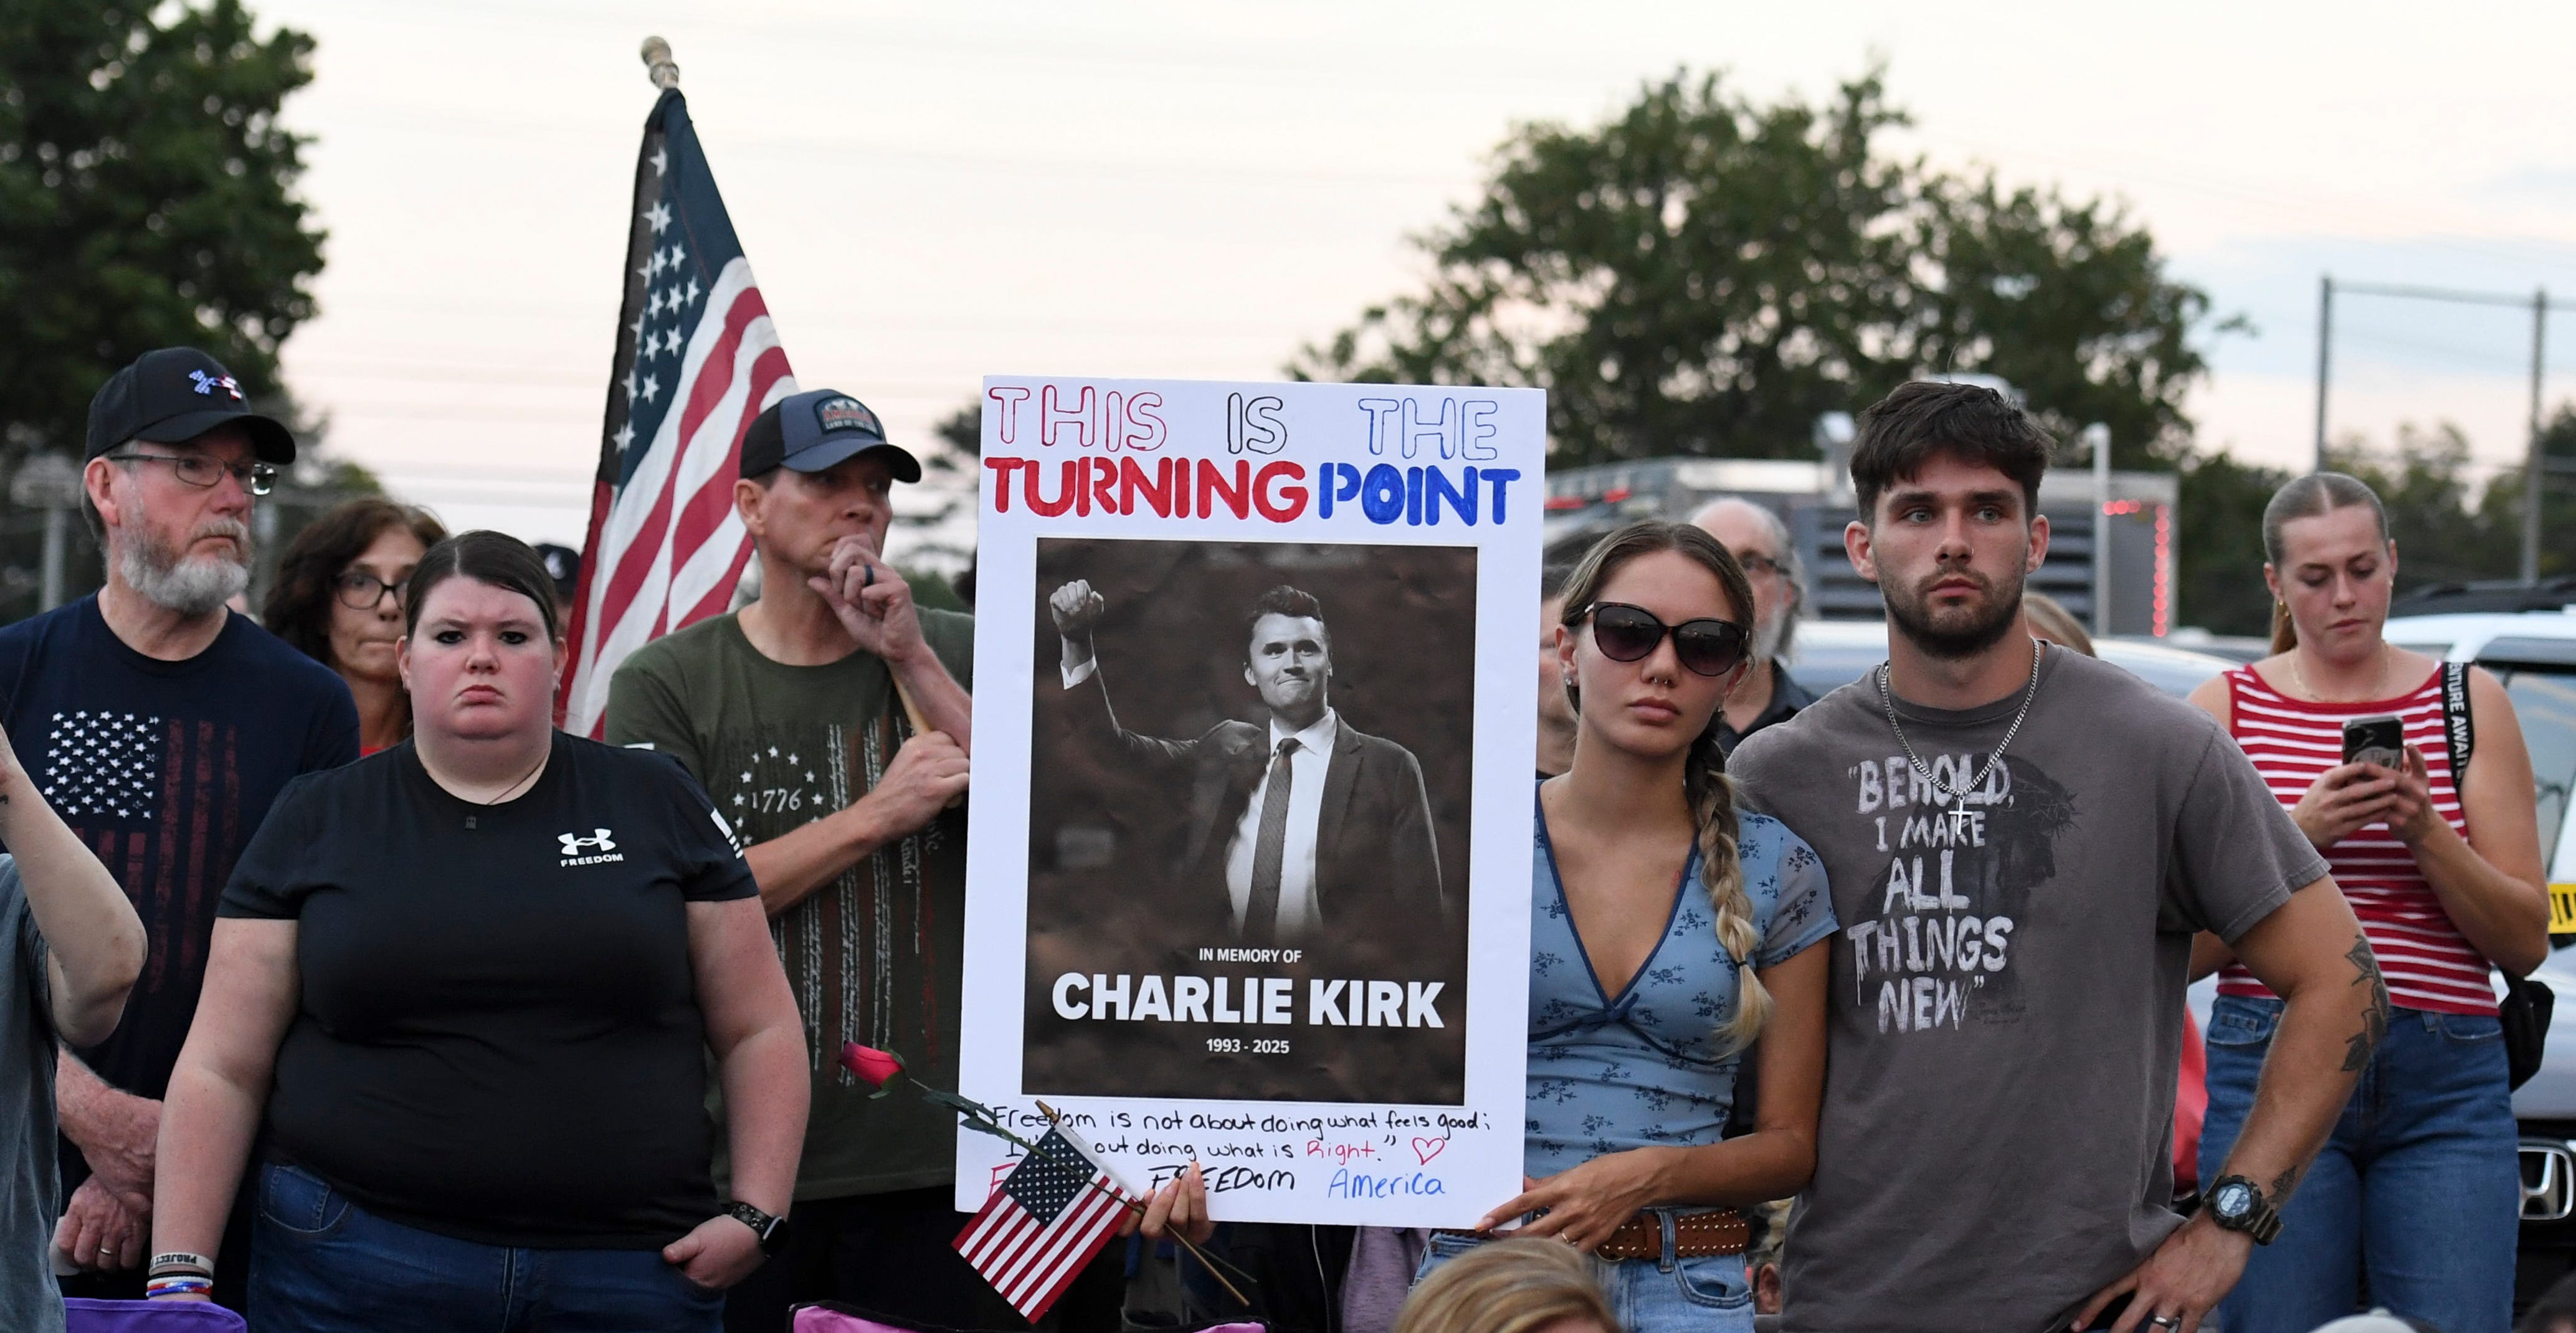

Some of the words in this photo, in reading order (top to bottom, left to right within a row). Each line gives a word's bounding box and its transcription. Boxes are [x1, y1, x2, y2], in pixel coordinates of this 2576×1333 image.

[988, 384, 1167, 453] THIS
[1227, 392, 1288, 455] IS
[1357, 397, 1498, 461] THE
[984, 456, 1309, 524] TURNING
[1318, 462, 1521, 527] POINT
[752, 788, 801, 813] 1776
[1875, 816, 1888, 852] I
[1900, 812, 1985, 849] MAKE
[561, 853, 624, 867] FREEDOM
[1883, 849, 1970, 914] ALL
[1199, 948, 1214, 961] IN
[1217, 948, 1280, 962] MEMORY
[1283, 950, 1302, 963] OF
[1847, 916, 2014, 1006] THINGS
[1052, 972, 1293, 1025] CHARLIE
[1309, 979, 1445, 1028] KIRK
[1206, 1038, 1240, 1053] 1993
[1252, 1039, 1290, 1054] 2025
[1110, 1111, 1132, 1128] is
[1143, 1109, 1184, 1131] not
[1189, 1112, 1256, 1131] about
[1260, 1114, 1324, 1141] doing
[1327, 1111, 1378, 1129] what
[1385, 1109, 1430, 1130] feels
[1136, 1137, 1197, 1162] doing
[1207, 1142, 1264, 1158] what
[1272, 1144, 1294, 1159] is
